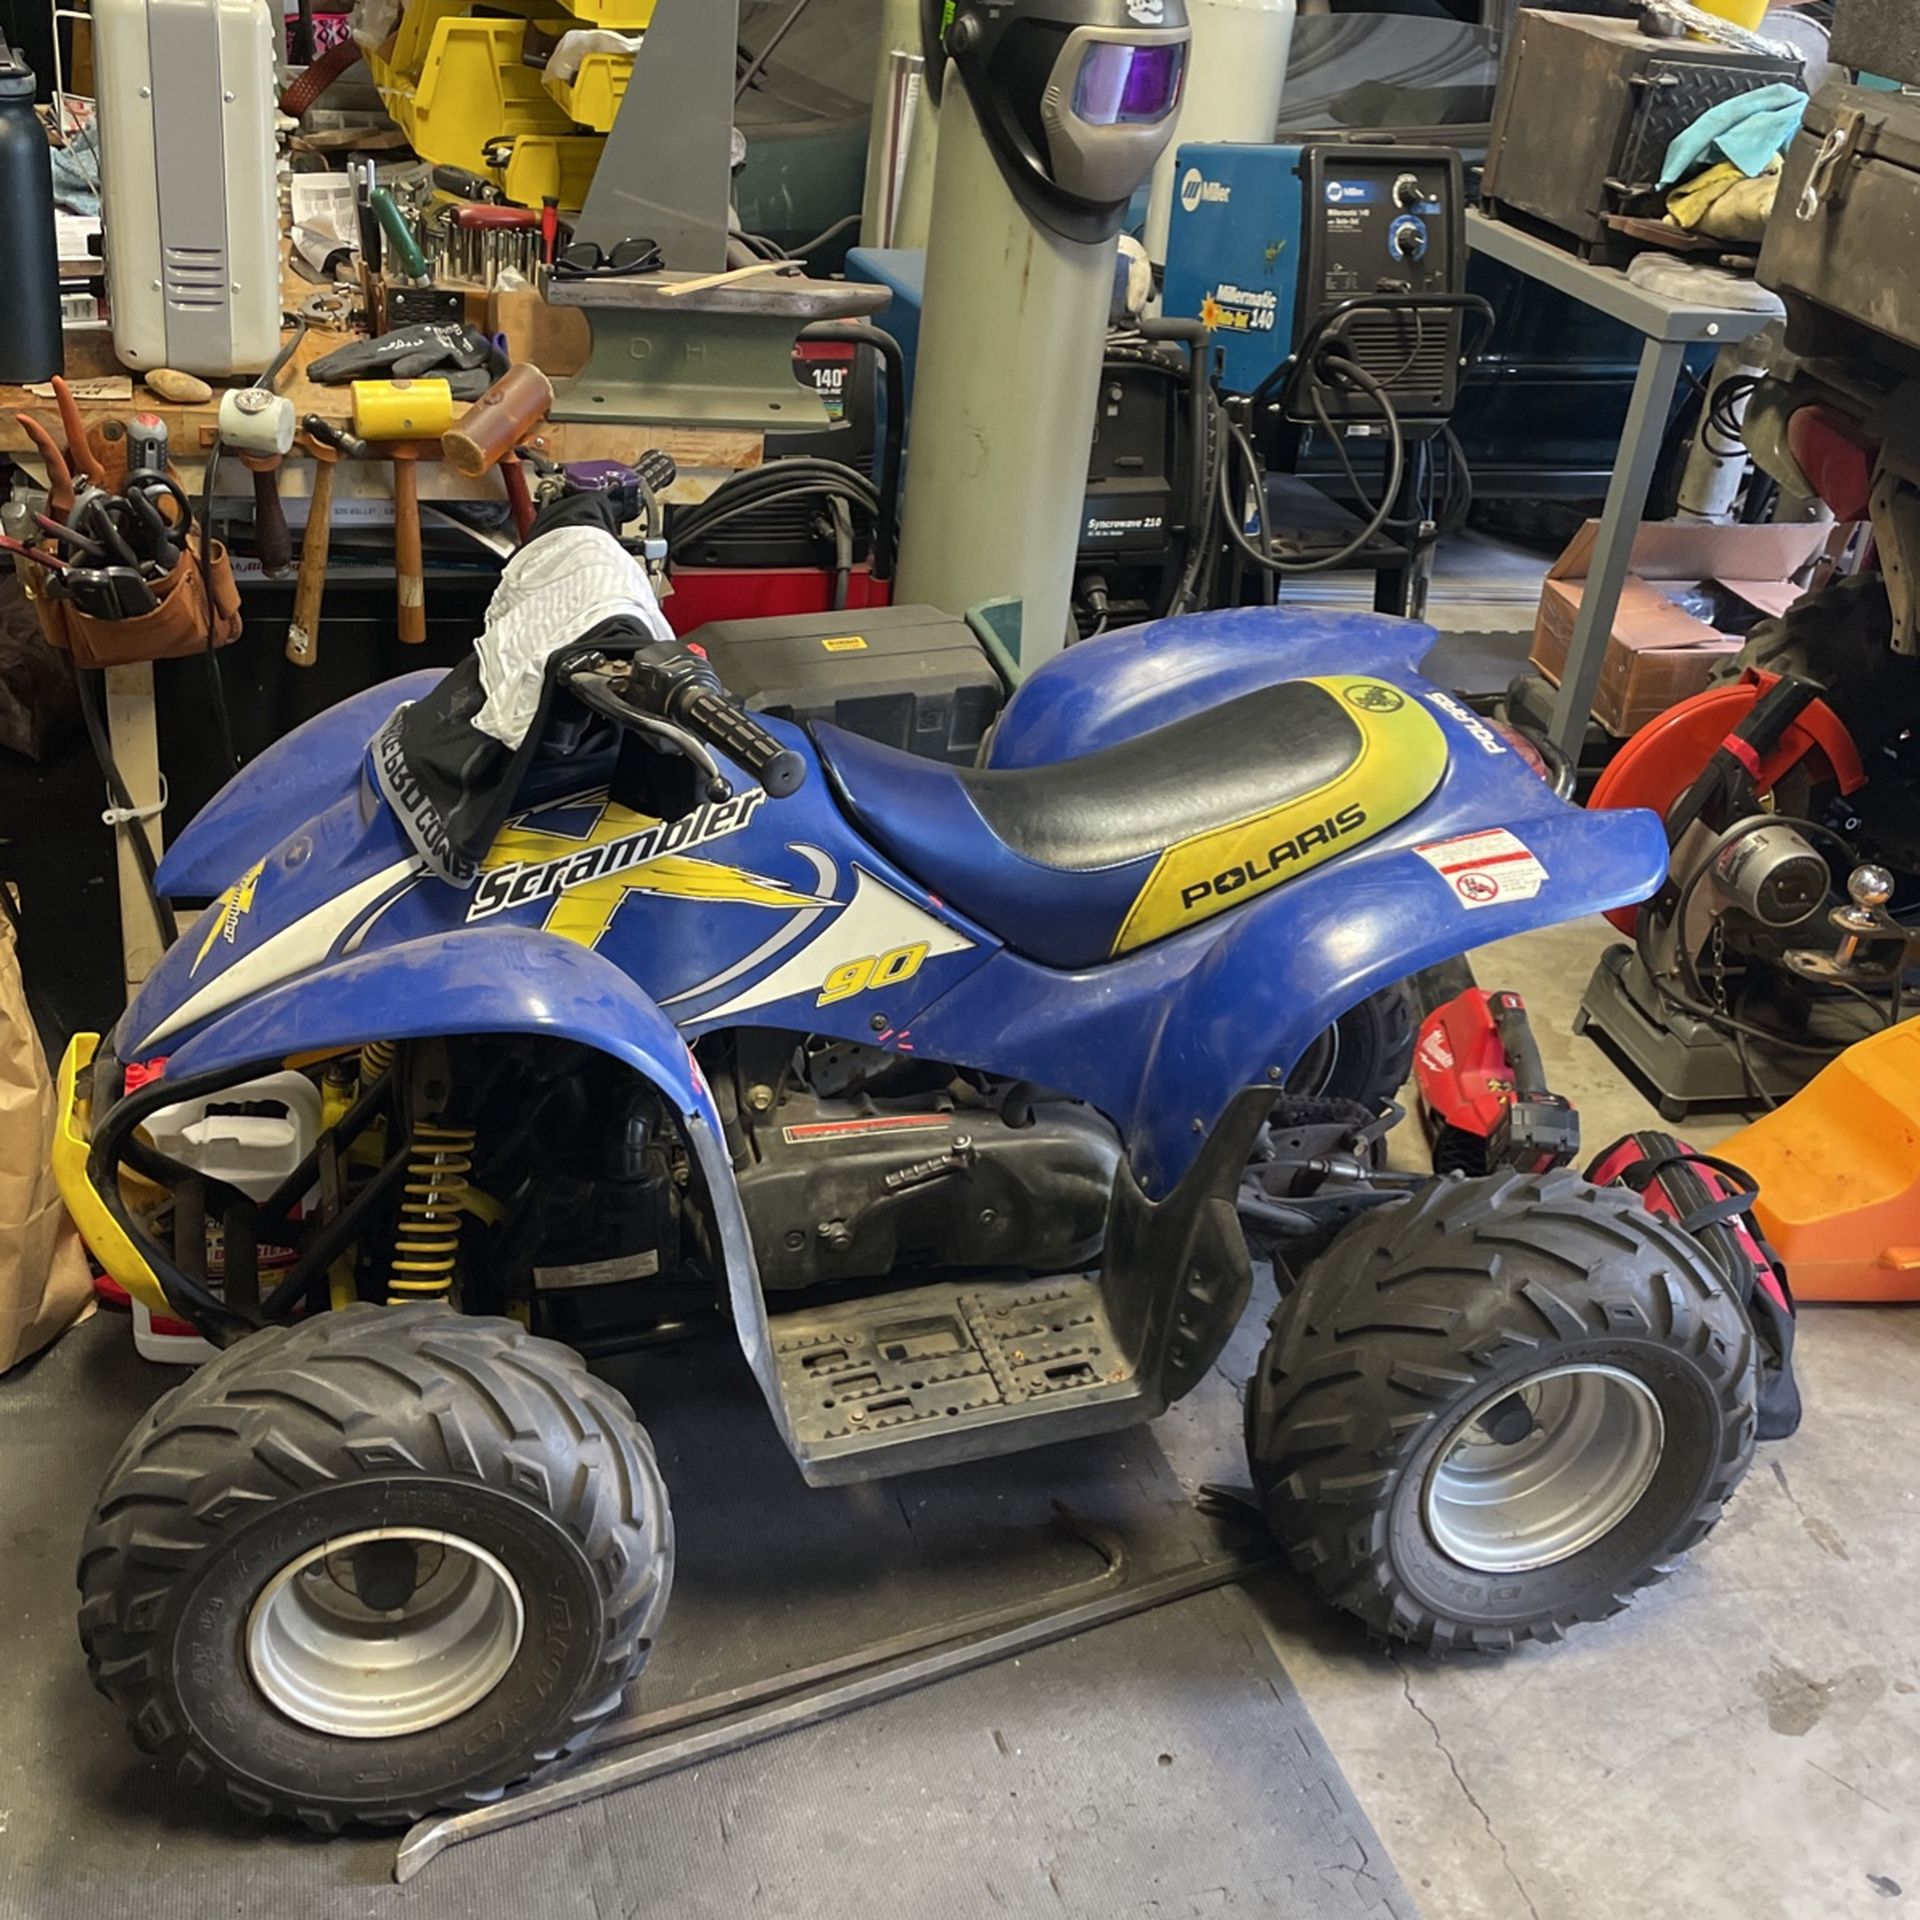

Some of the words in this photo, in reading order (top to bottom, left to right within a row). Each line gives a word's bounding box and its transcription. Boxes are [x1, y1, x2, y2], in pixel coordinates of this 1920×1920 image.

[1201, 181, 1231, 203] Miller
[1216, 284, 1277, 309] Millermatic
[1250, 308, 1275, 330] 140
[812, 368, 842, 388] 140
[1087, 518, 1142, 530] Syncrowave
[1143, 516, 1163, 528] 210
[1424, 692, 1507, 753] POLARIS
[466, 788, 766, 923] Scrambler
[1181, 803, 1367, 910] POLARIS
[816, 941, 931, 1008] 90
